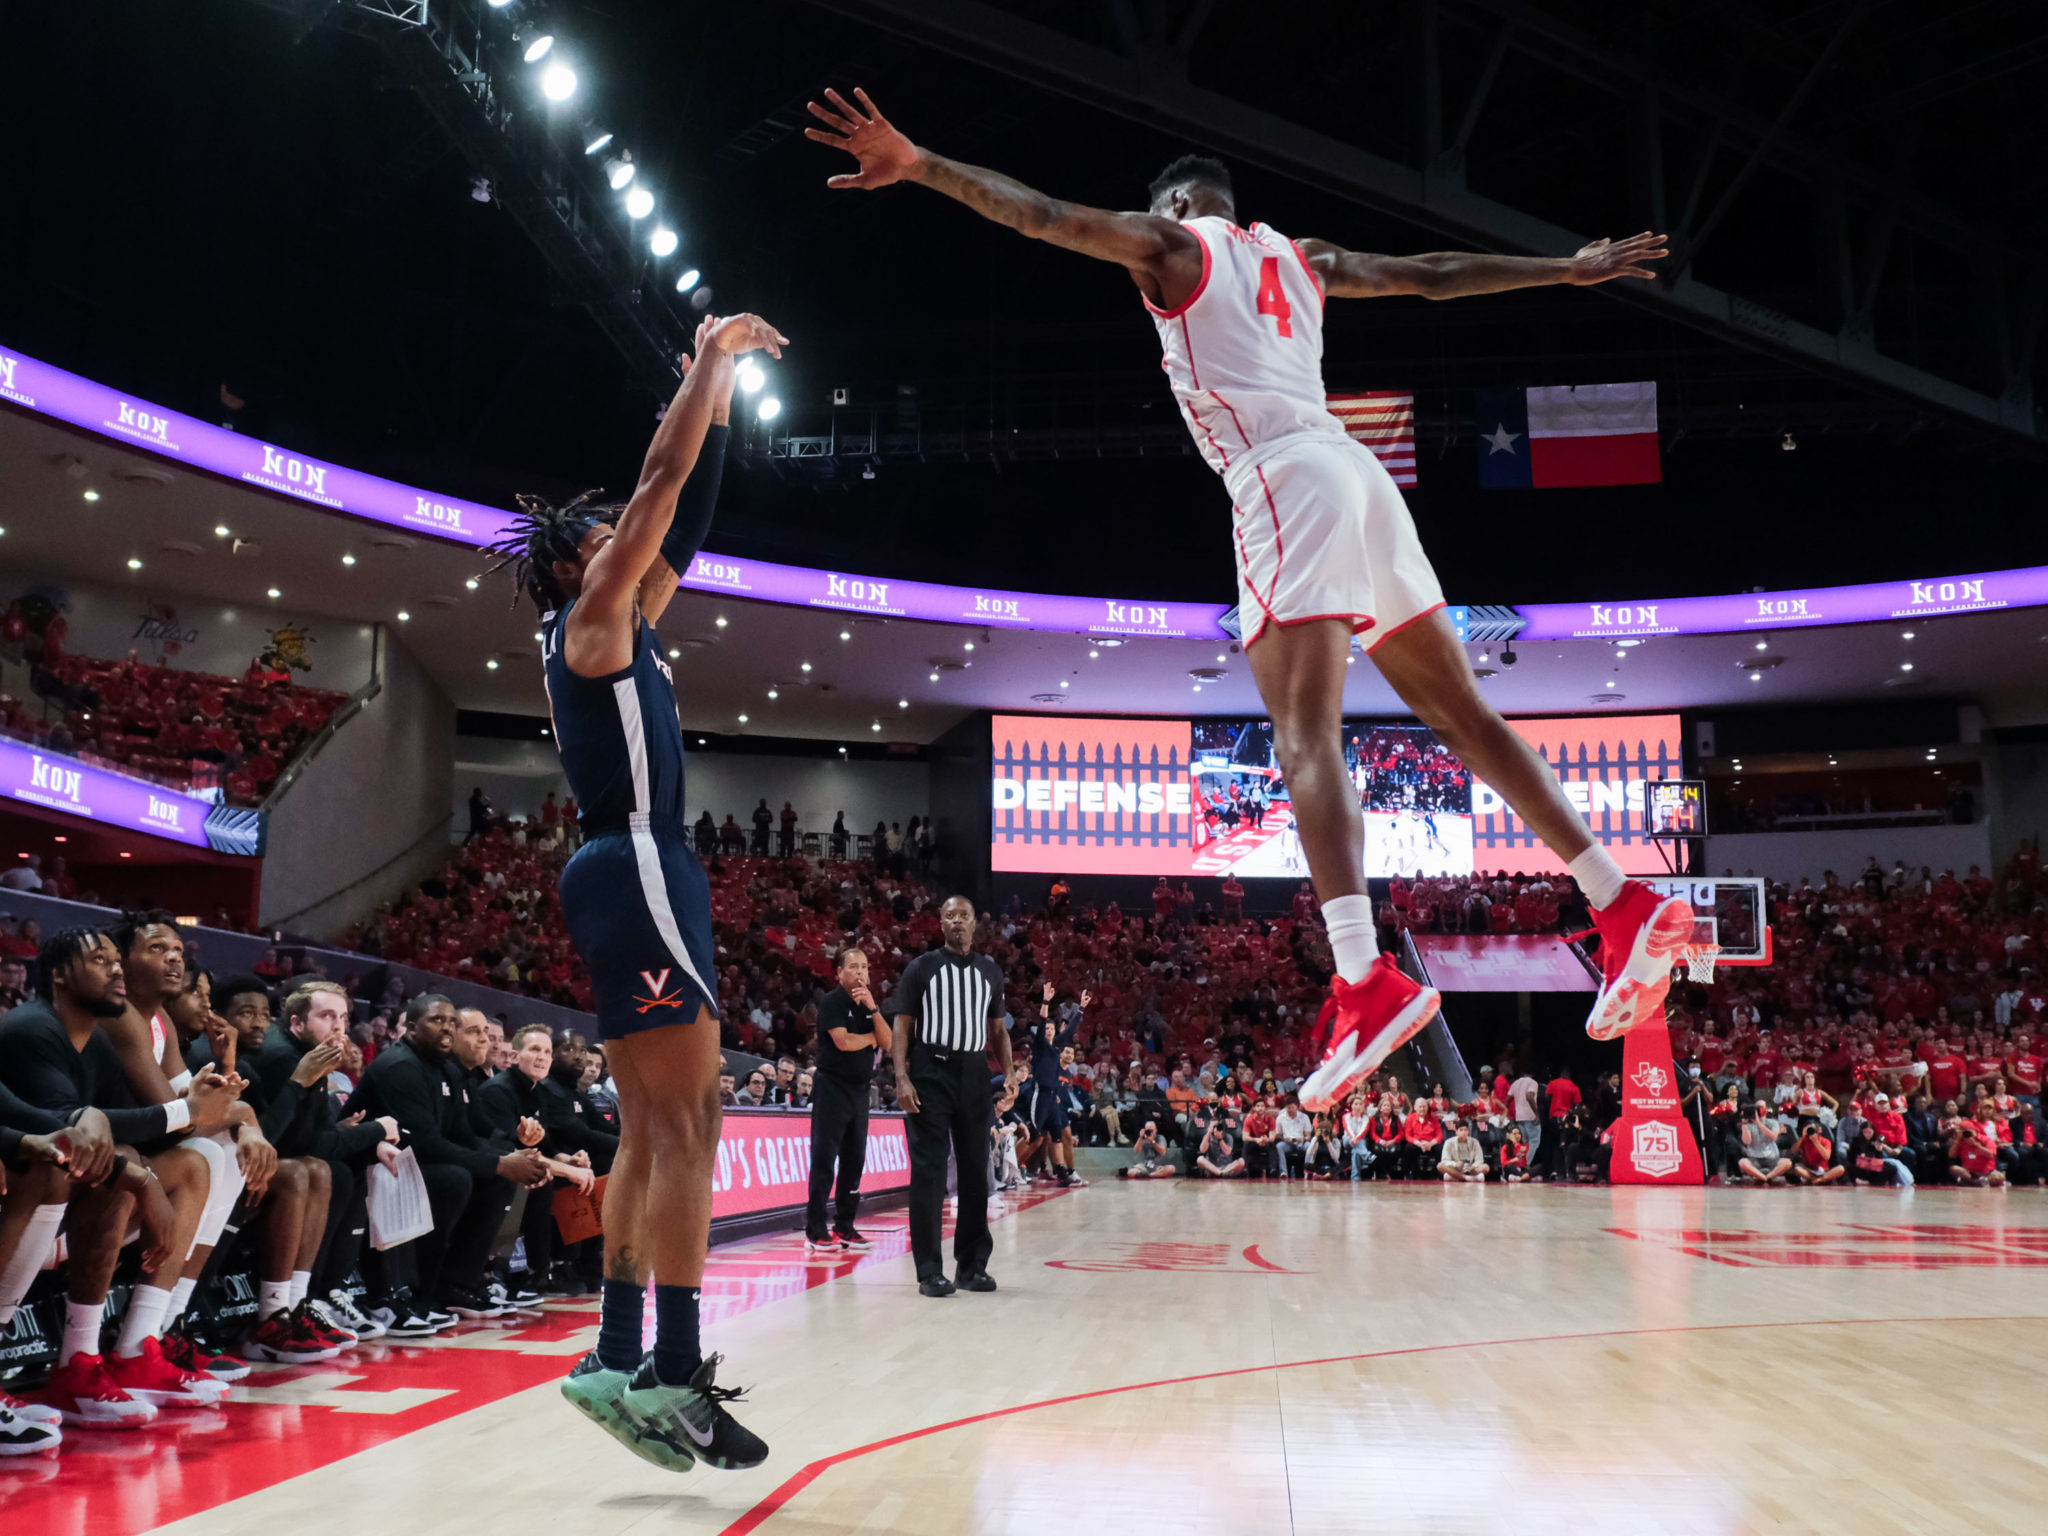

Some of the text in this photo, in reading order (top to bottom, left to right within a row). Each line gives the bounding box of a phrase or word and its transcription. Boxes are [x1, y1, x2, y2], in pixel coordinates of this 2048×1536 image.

[1256, 257, 1293, 338] 4
[118, 401, 168, 440] KON
[262, 445, 327, 494] KON
[416, 496, 462, 527] KON
[697, 559, 741, 583] KON
[827, 574, 888, 606] KON
[1910, 580, 1984, 604] KON
[975, 595, 1018, 616] KON
[1106, 601, 1168, 628] KON
[1590, 605, 1659, 627] KON
[1757, 600, 1809, 615] KON
[132, 614, 199, 644] Tulsa
[31, 755, 82, 803] KON
[993, 778, 1191, 814] DEFENSE
[1471, 779, 1646, 815] DENS
[862, 1134, 908, 1175] URGERS
[1643, 1137, 1669, 1152] 75
[0, 1339, 49, 1360] ropractic
